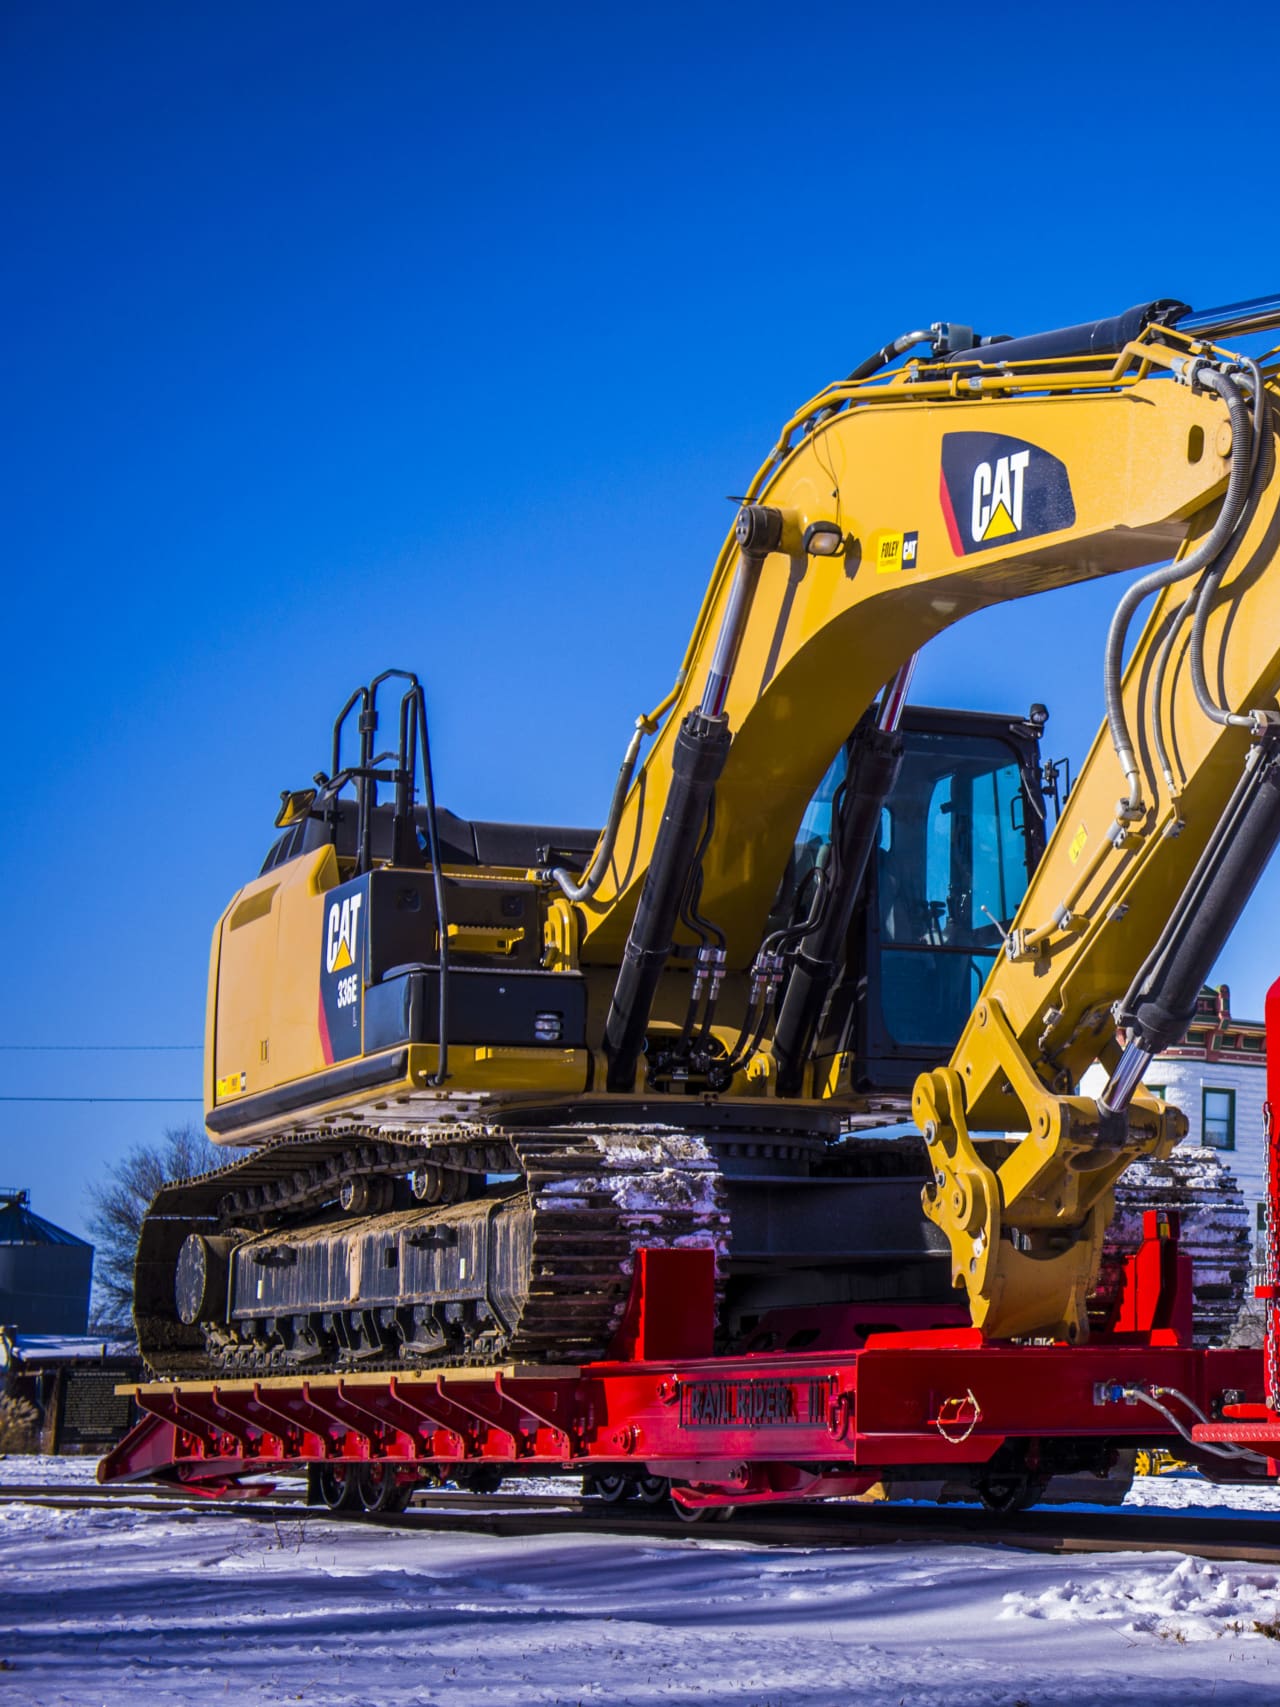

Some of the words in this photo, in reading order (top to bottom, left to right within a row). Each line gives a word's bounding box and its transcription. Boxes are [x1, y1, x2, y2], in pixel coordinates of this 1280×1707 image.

[971, 450, 1030, 543] CAT
[880, 540, 899, 558] FOLEY
[902, 540, 917, 561] CAT
[326, 892, 362, 974] CAT
[337, 974, 358, 1009] 336E
[692, 1387, 730, 1419] RAIL
[736, 1386, 789, 1418] RIDER
